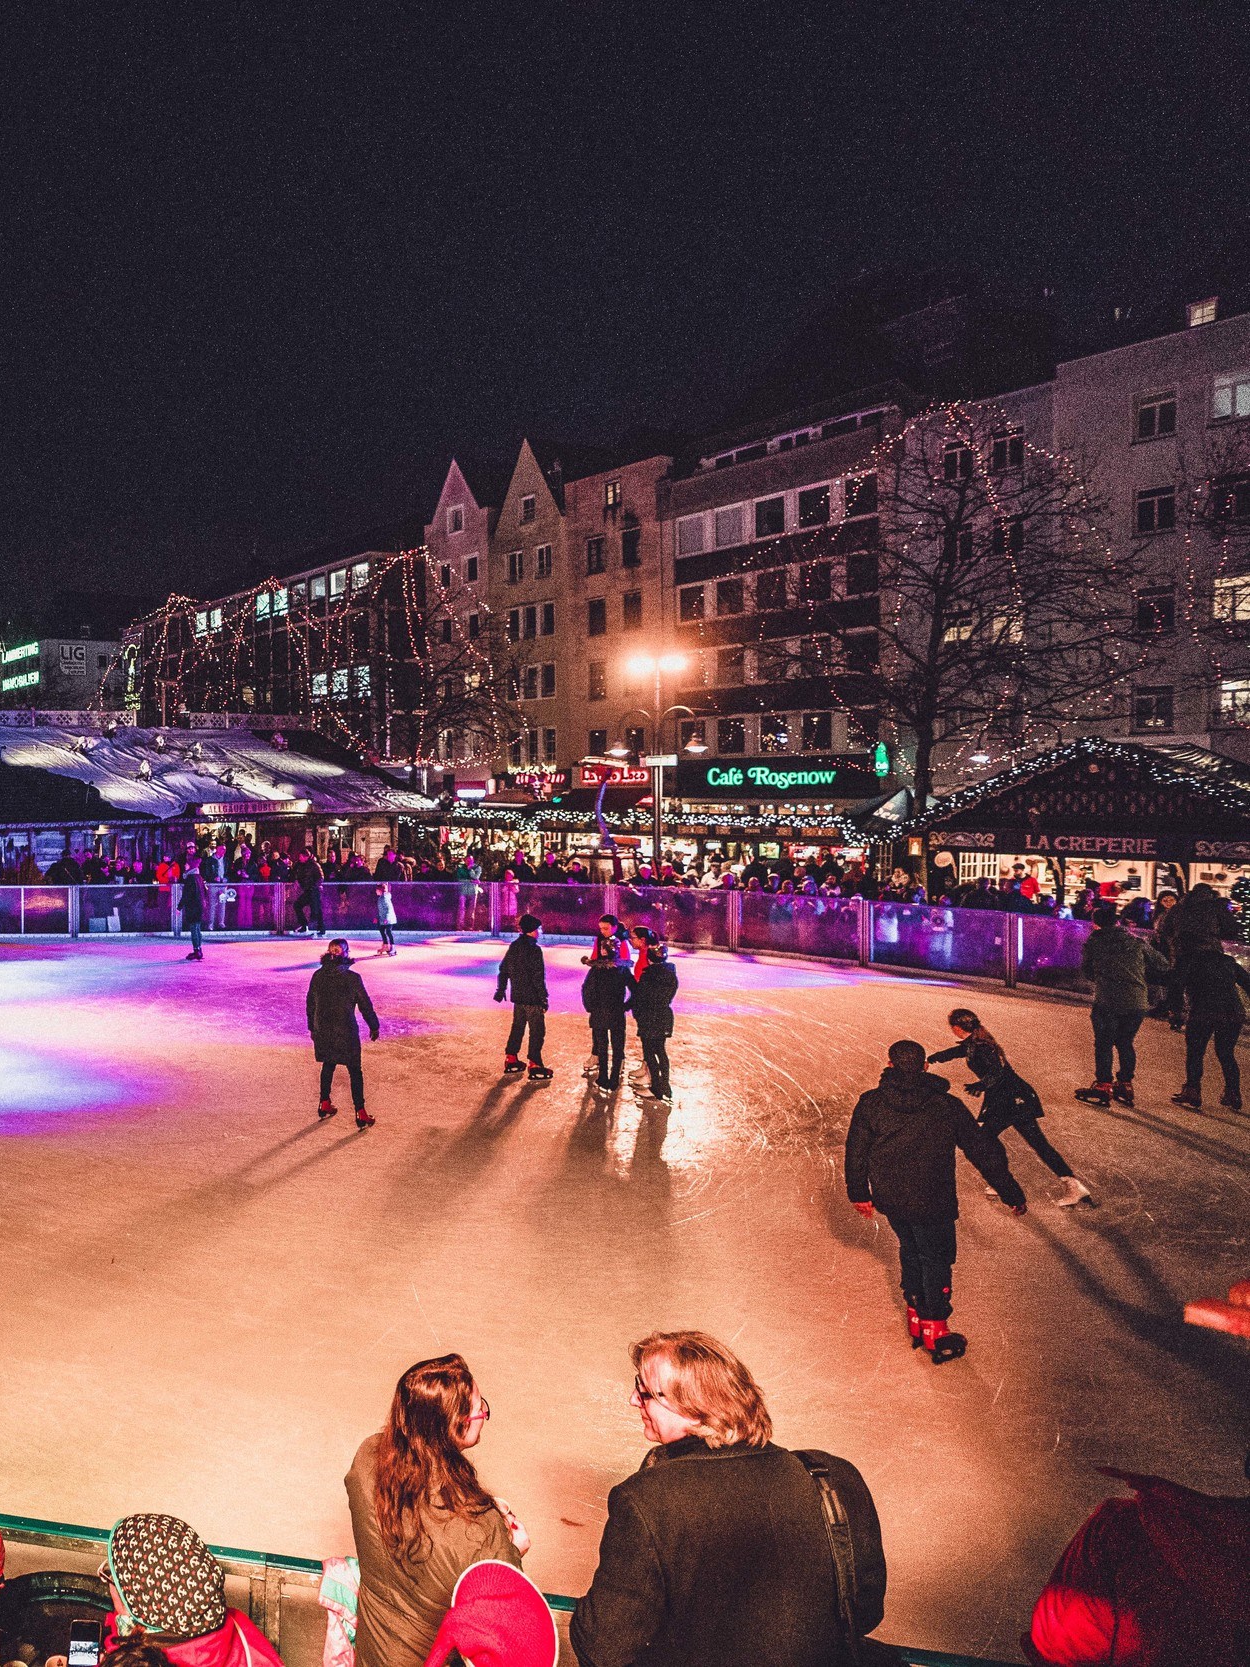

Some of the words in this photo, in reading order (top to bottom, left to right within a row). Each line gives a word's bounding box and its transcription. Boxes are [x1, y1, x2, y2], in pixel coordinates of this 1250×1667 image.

[61, 646, 85, 661] LIG
[707, 767, 743, 786] Café
[747, 767, 837, 789] Rosenow
[1025, 835, 1050, 850] LA
